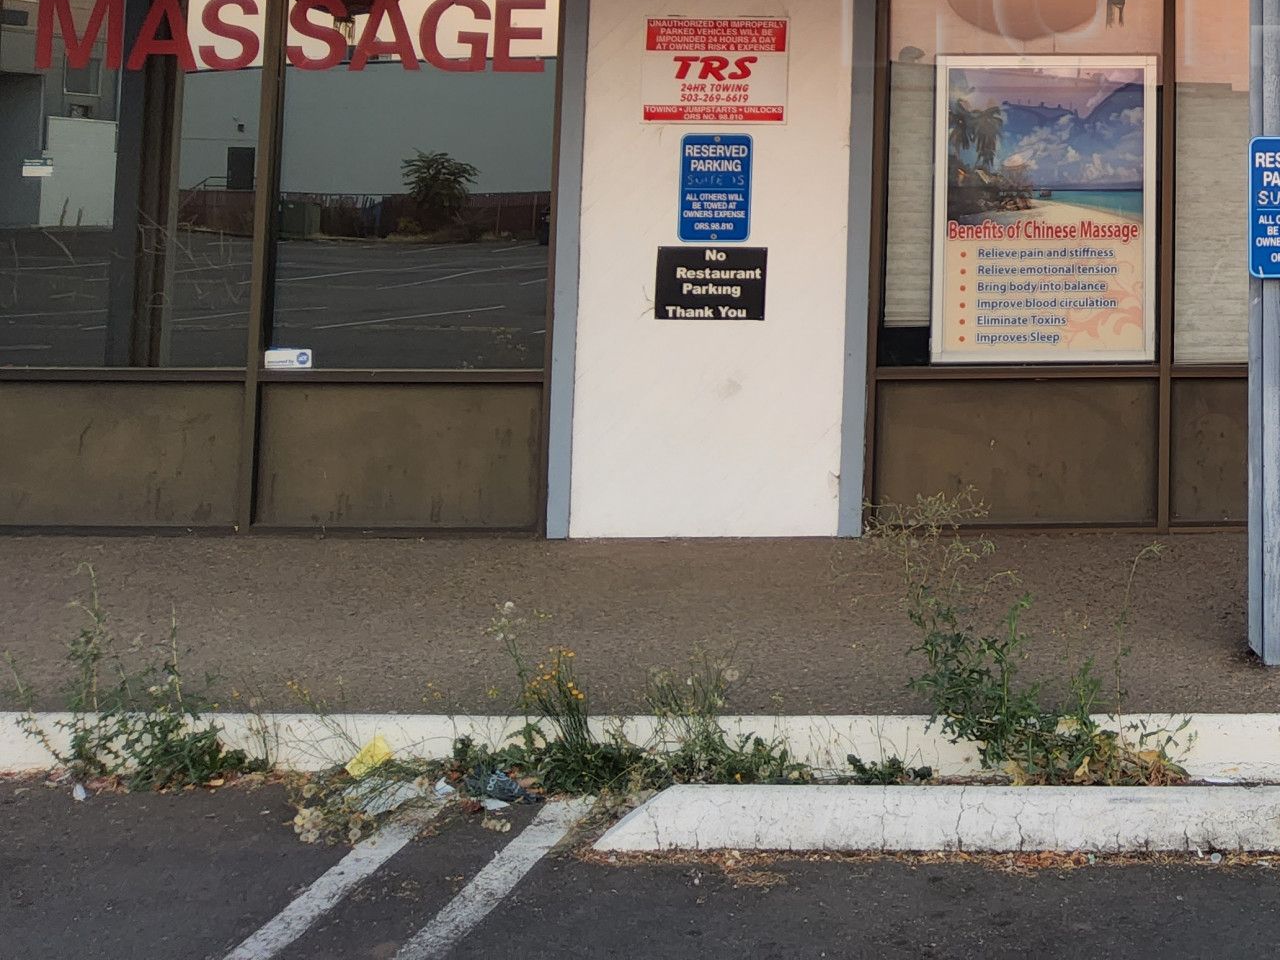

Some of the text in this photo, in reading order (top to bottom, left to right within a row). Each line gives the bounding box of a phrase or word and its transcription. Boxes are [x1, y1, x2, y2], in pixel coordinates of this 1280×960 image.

[673, 56, 758, 81] TRS
[681, 83, 749, 92] 24HR TOWING
[680, 93, 749, 102] 503-269-6619
[685, 145, 748, 157] RESERVED
[691, 160, 742, 171] PARKING
[686, 193, 744, 201] ALL OTHERS WILL
[1258, 215, 1274, 224] ALL
[949, 220, 1138, 241] Benefits of Chinese Massage
[1267, 226, 1279, 235] BE
[704, 249, 726, 261] No
[978, 248, 1113, 259] Relieve pain and stiffness
[676, 267, 762, 279] Restaurant
[977, 265, 1118, 274] Relieve emotional tension
[682, 283, 741, 297] Parking
[977, 282, 1106, 293] Bring body into balance
[977, 299, 1117, 310] Improve blood circulation
[665, 306, 747, 317] Thank You
[977, 315, 1066, 325] Eliminate Toxins
[977, 332, 1060, 344] Improves Sleep
